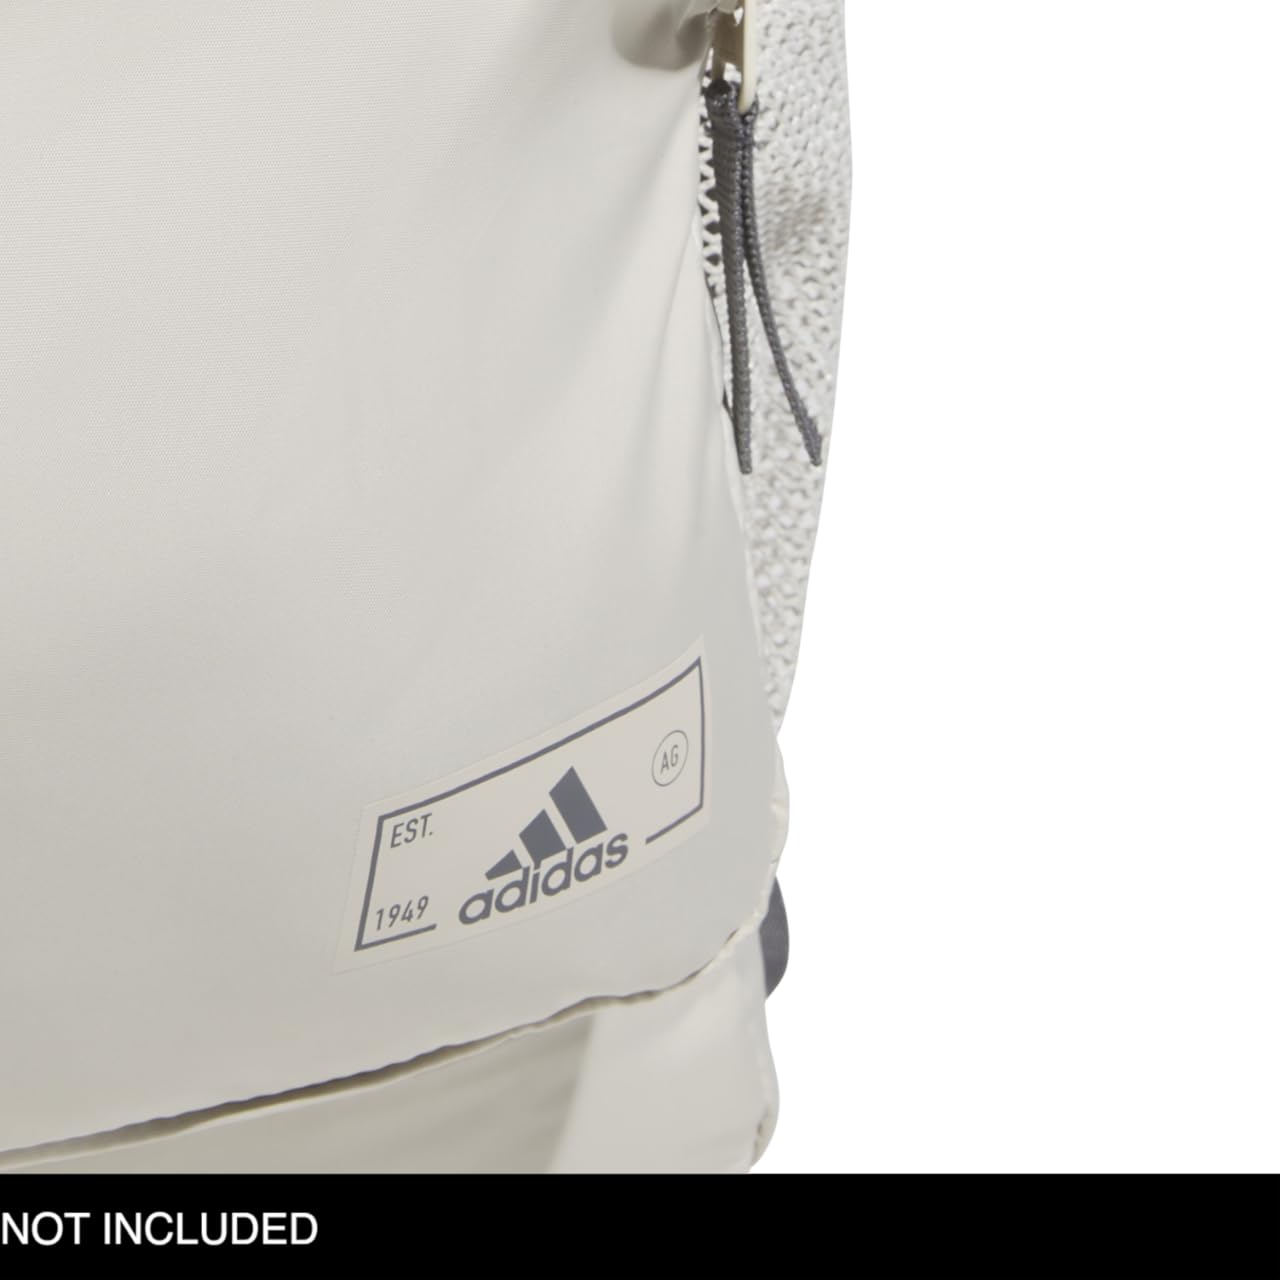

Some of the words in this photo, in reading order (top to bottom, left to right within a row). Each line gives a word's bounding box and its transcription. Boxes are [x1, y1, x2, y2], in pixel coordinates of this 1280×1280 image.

[659, 743, 679, 774] AG
[389, 812, 434, 849] EST.
[458, 832, 629, 925] adidas
[375, 895, 430, 931] 1949
